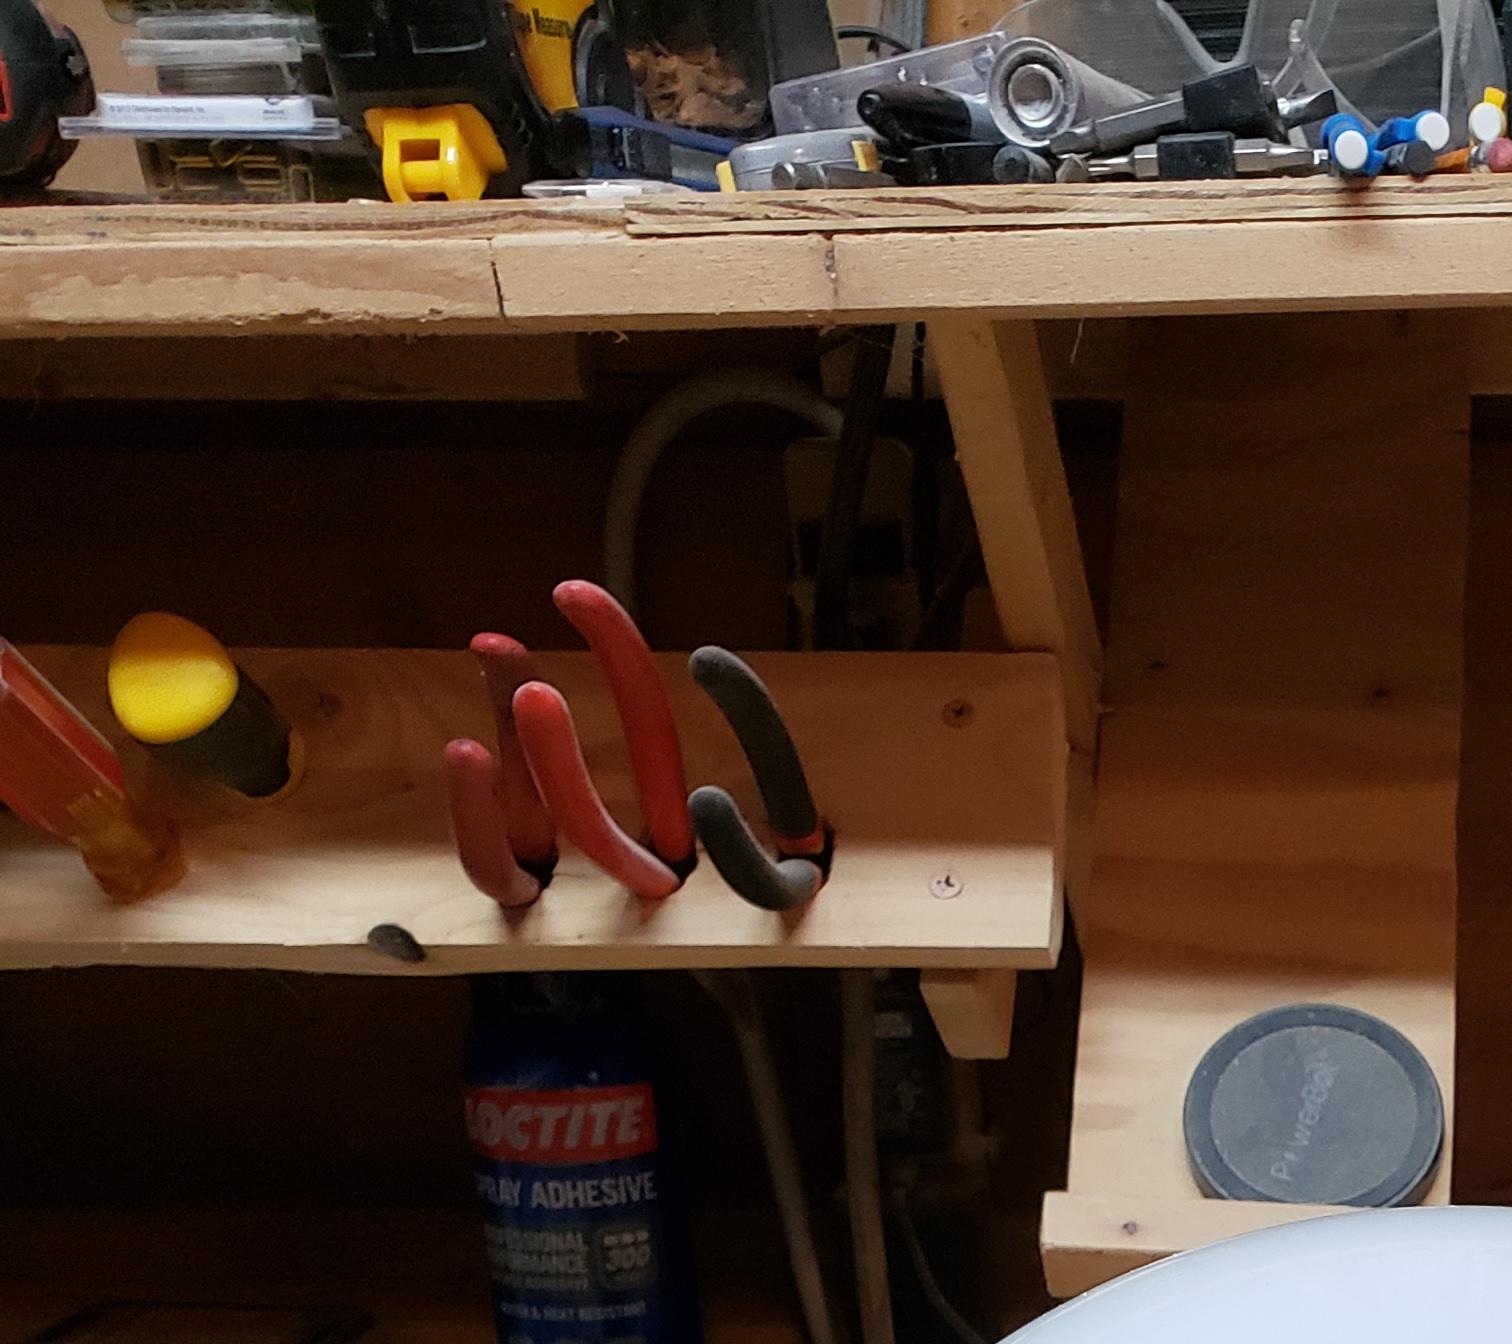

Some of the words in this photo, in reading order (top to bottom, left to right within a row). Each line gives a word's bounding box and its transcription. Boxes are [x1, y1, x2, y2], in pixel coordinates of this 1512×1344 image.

[465, 1095, 646, 1151] LOCTITE
[475, 1171, 522, 1208] PRAY
[530, 1172, 658, 1210] ADHESIVE
